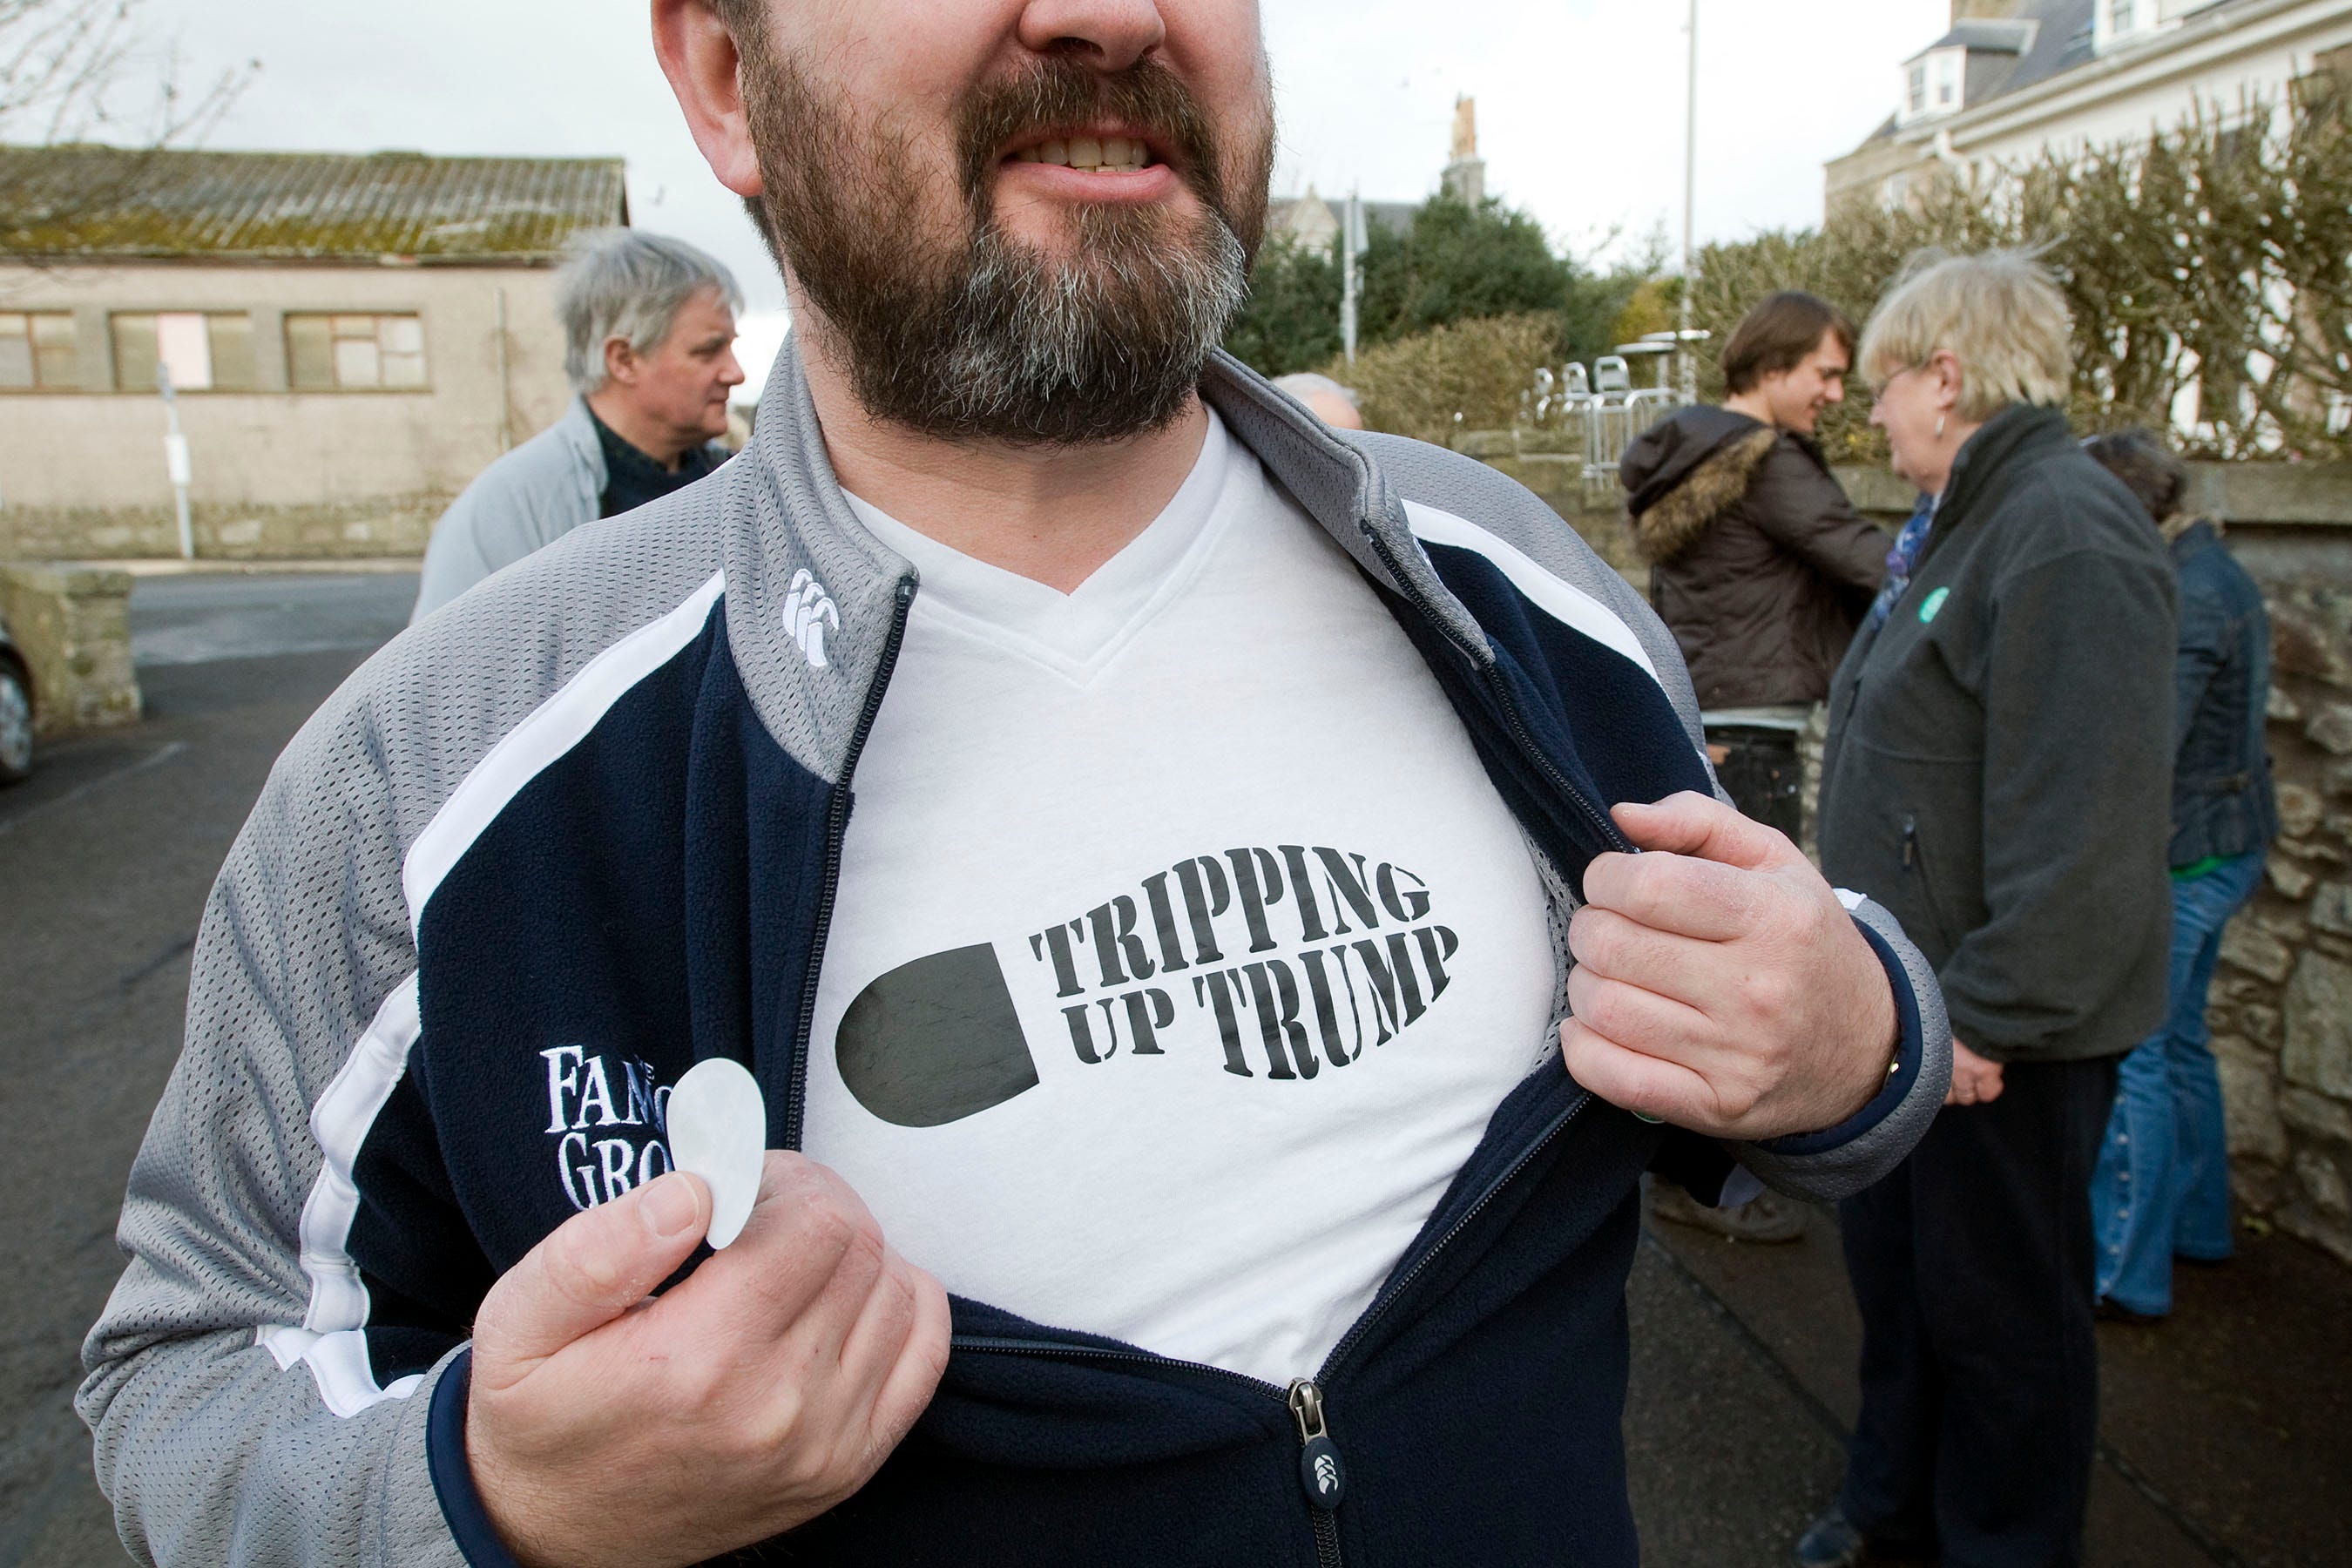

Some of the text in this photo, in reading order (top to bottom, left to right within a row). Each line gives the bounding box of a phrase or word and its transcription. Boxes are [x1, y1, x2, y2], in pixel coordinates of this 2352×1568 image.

[1028, 845, 1430, 998] TRIPPING
[1060, 925, 1459, 1080] UP TRUMP
